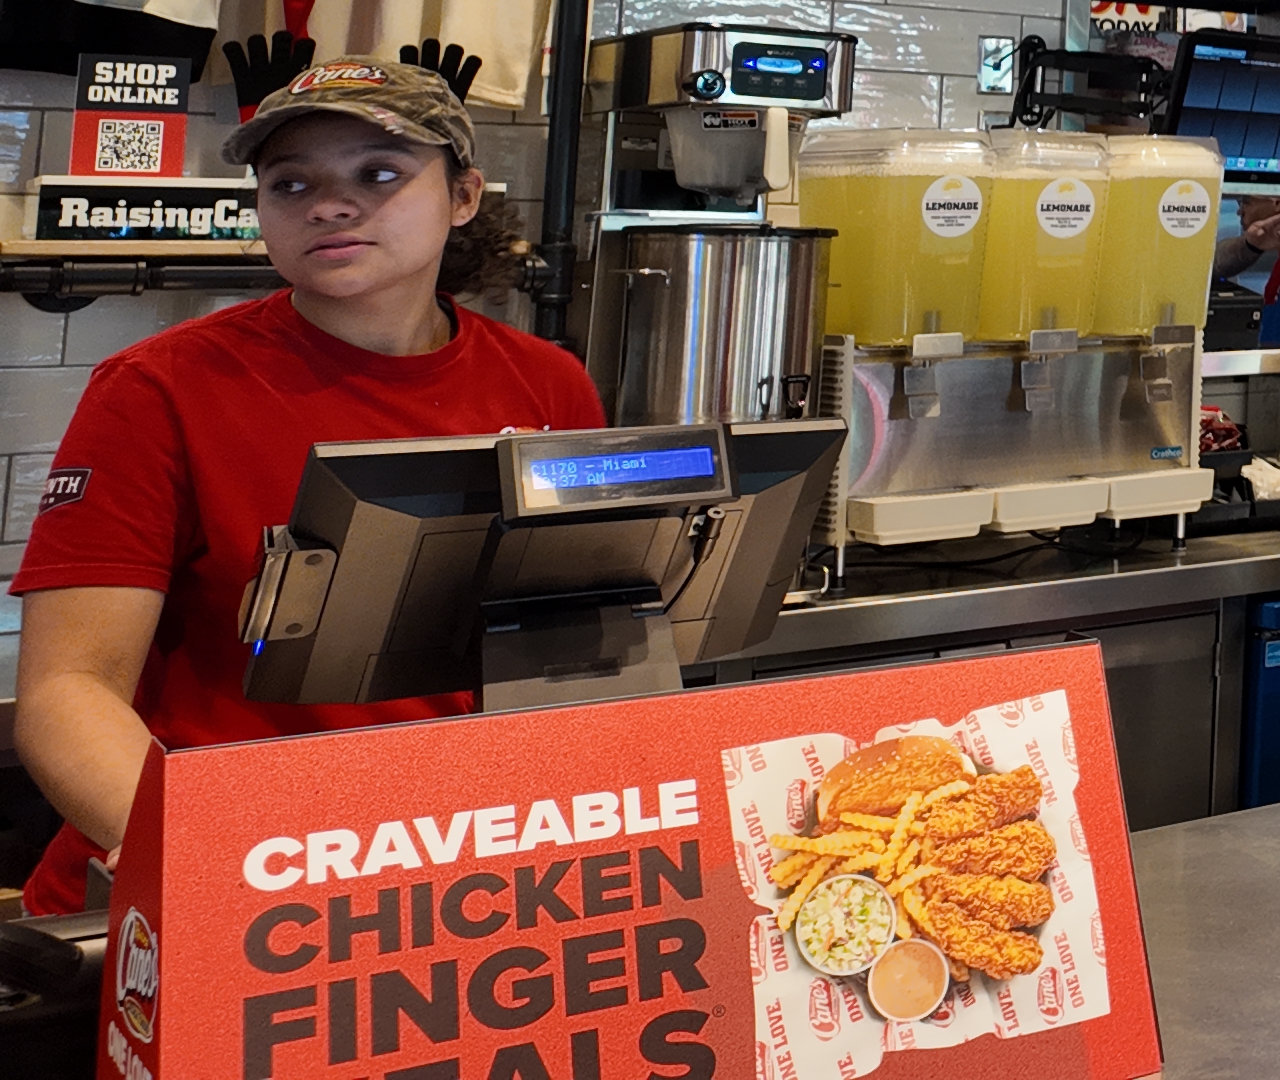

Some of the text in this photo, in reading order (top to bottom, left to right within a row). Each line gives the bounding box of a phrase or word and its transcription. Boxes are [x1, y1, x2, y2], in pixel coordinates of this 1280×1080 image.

[94, 62, 177, 86] SHOP
[289, 64, 388, 95] Cane's
[88, 86, 179, 106] ONLINE
[925, 201, 979, 211] LEMONADE
[1040, 203, 1091, 213] LEMONADE
[1161, 204, 1207, 214] LEMONADE
[603, 458, 647, 471] Miami
[587, 472, 606, 485] AM
[242, 778, 700, 891] CRAVEABLE
[242, 839, 704, 975] CHICKEN
[242, 918, 712, 1080] FINGER
